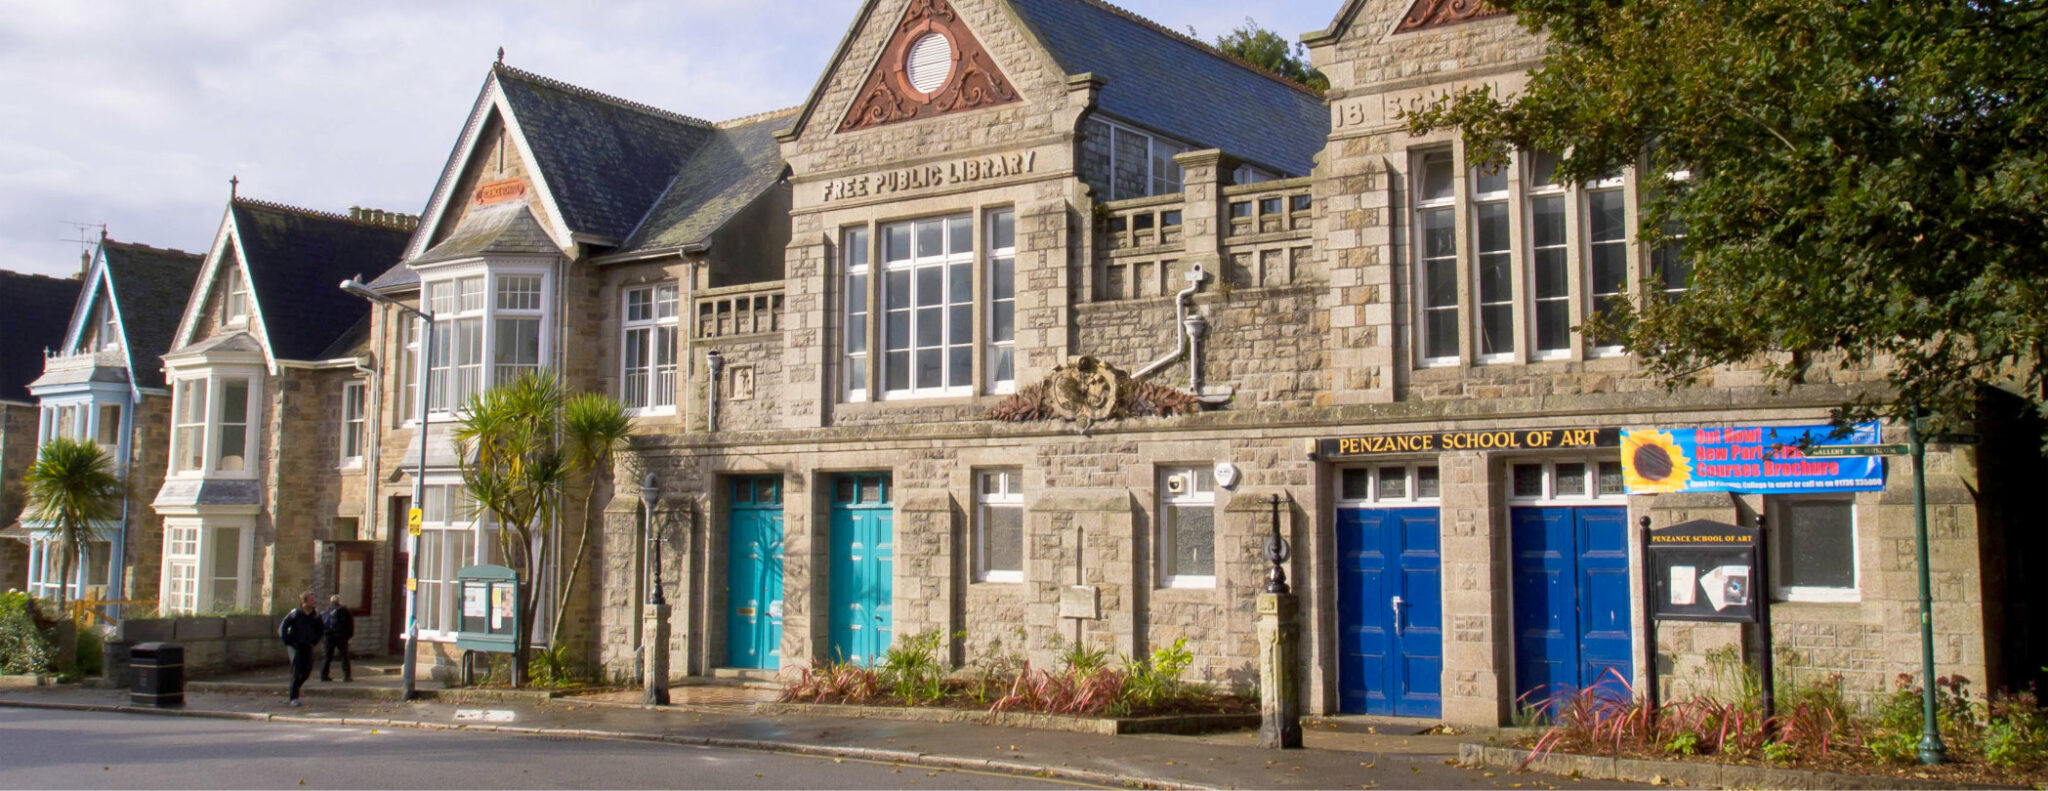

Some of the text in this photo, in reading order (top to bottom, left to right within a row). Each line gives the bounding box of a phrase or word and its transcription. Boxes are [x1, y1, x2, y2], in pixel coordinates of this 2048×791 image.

[1336, 80, 1515, 127] 18 SCHL
[823, 151, 1036, 202] FREE PUBLIC LIBRARY
[1339, 429, 1600, 454] PENZANCE SCHOOL OF ART
[1694, 427, 1763, 445] Out Now!
[1694, 445, 1728, 461] New
[1696, 460, 1839, 478] Courses Brochure
[1652, 535, 1752, 543] PENZANCE SCHOOL OF ART
